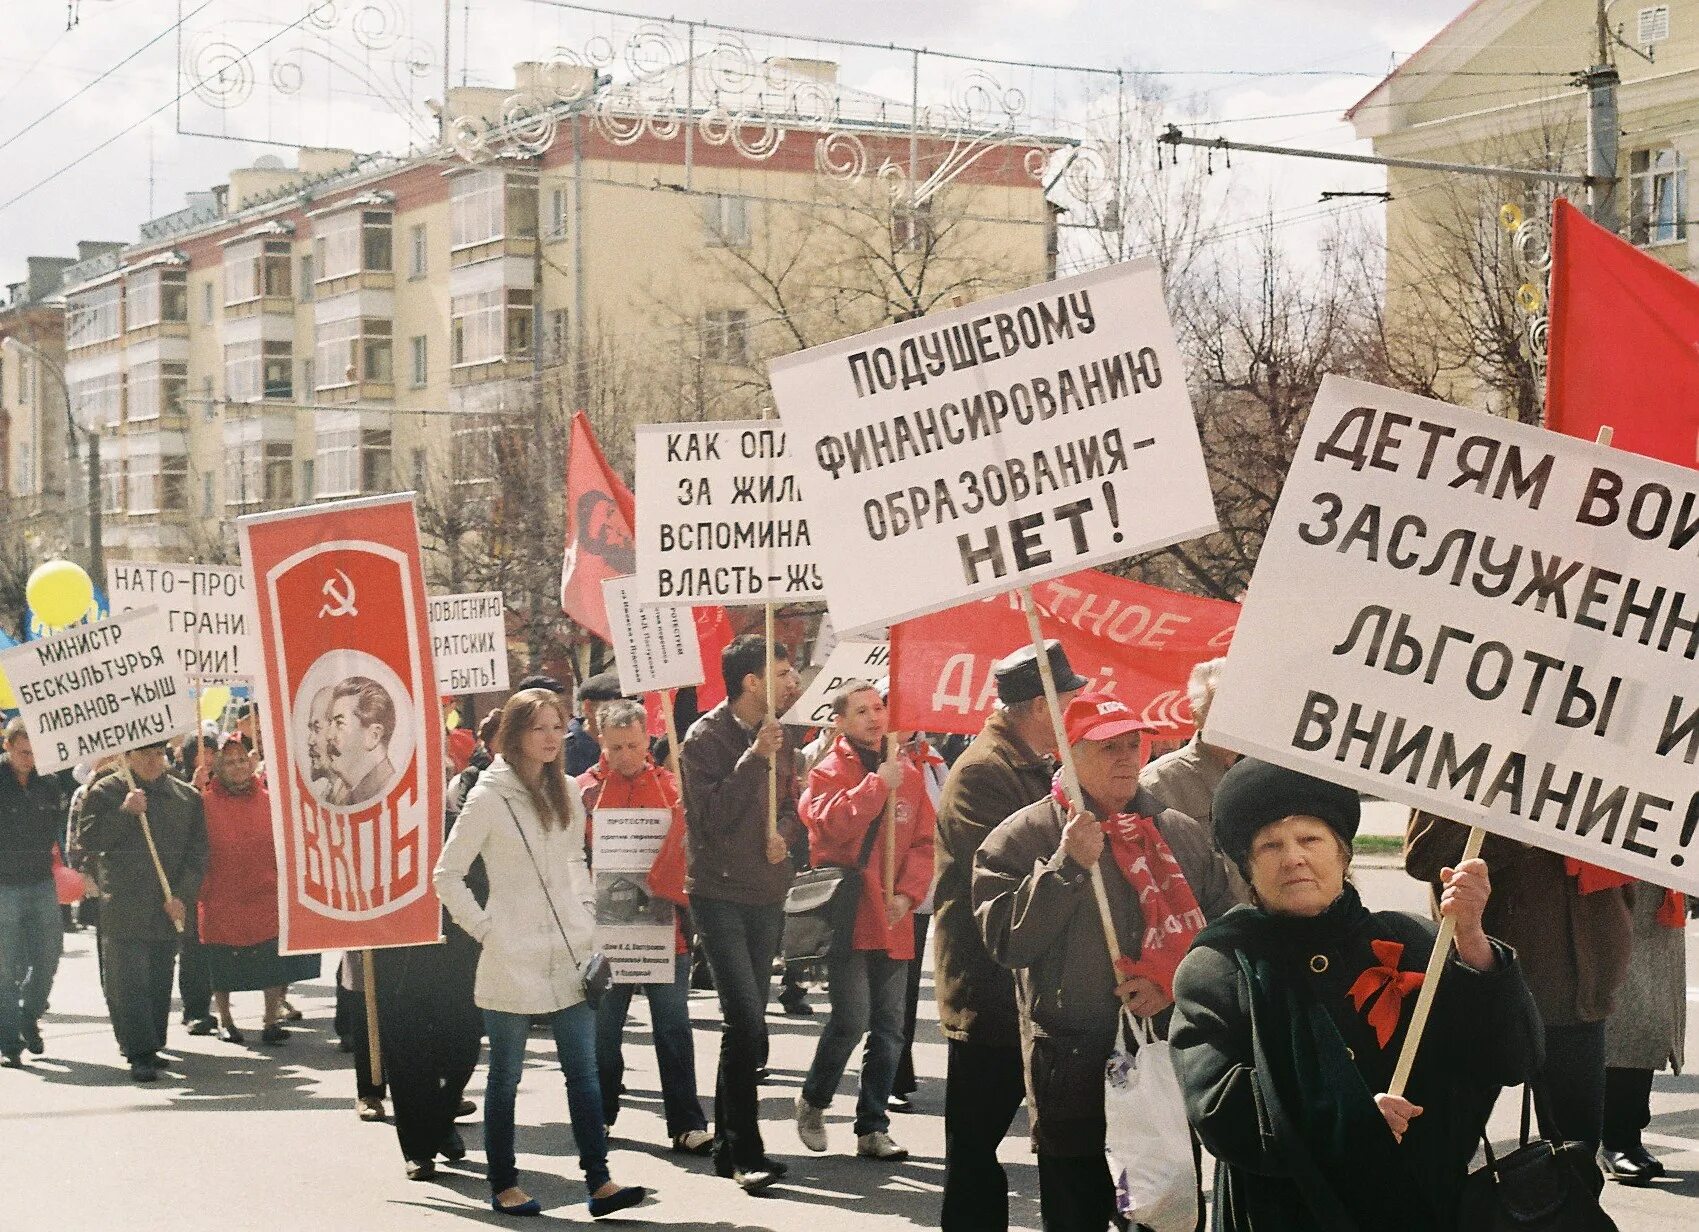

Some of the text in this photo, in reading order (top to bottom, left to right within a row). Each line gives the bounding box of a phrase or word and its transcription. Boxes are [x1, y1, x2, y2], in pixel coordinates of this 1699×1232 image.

[847, 290, 1096, 398] ПОДУШЕВОМУ
[815, 346, 1163, 480] ФИНАНСИРОВАНИЮ
[668, 432, 721, 462] КАК
[1314, 407, 1555, 510] ДЕТЯМ
[677, 477, 712, 506] ЗА
[660, 519, 811, 552] ВСПОМИНА
[957, 481, 1124, 586] НЕТ!
[36, 624, 122, 666] МИНИСТР
[433, 632, 496, 657] РАТСКИХ
[20, 645, 165, 704] БЕСКУЛЬТУРЬЯ
[1332, 605, 1699, 765] ЛЬГОТЫ И
[56, 704, 174, 762] В АМЕРИКУ!
[1291, 690, 1699, 867] ВНИМАНИЕ!
